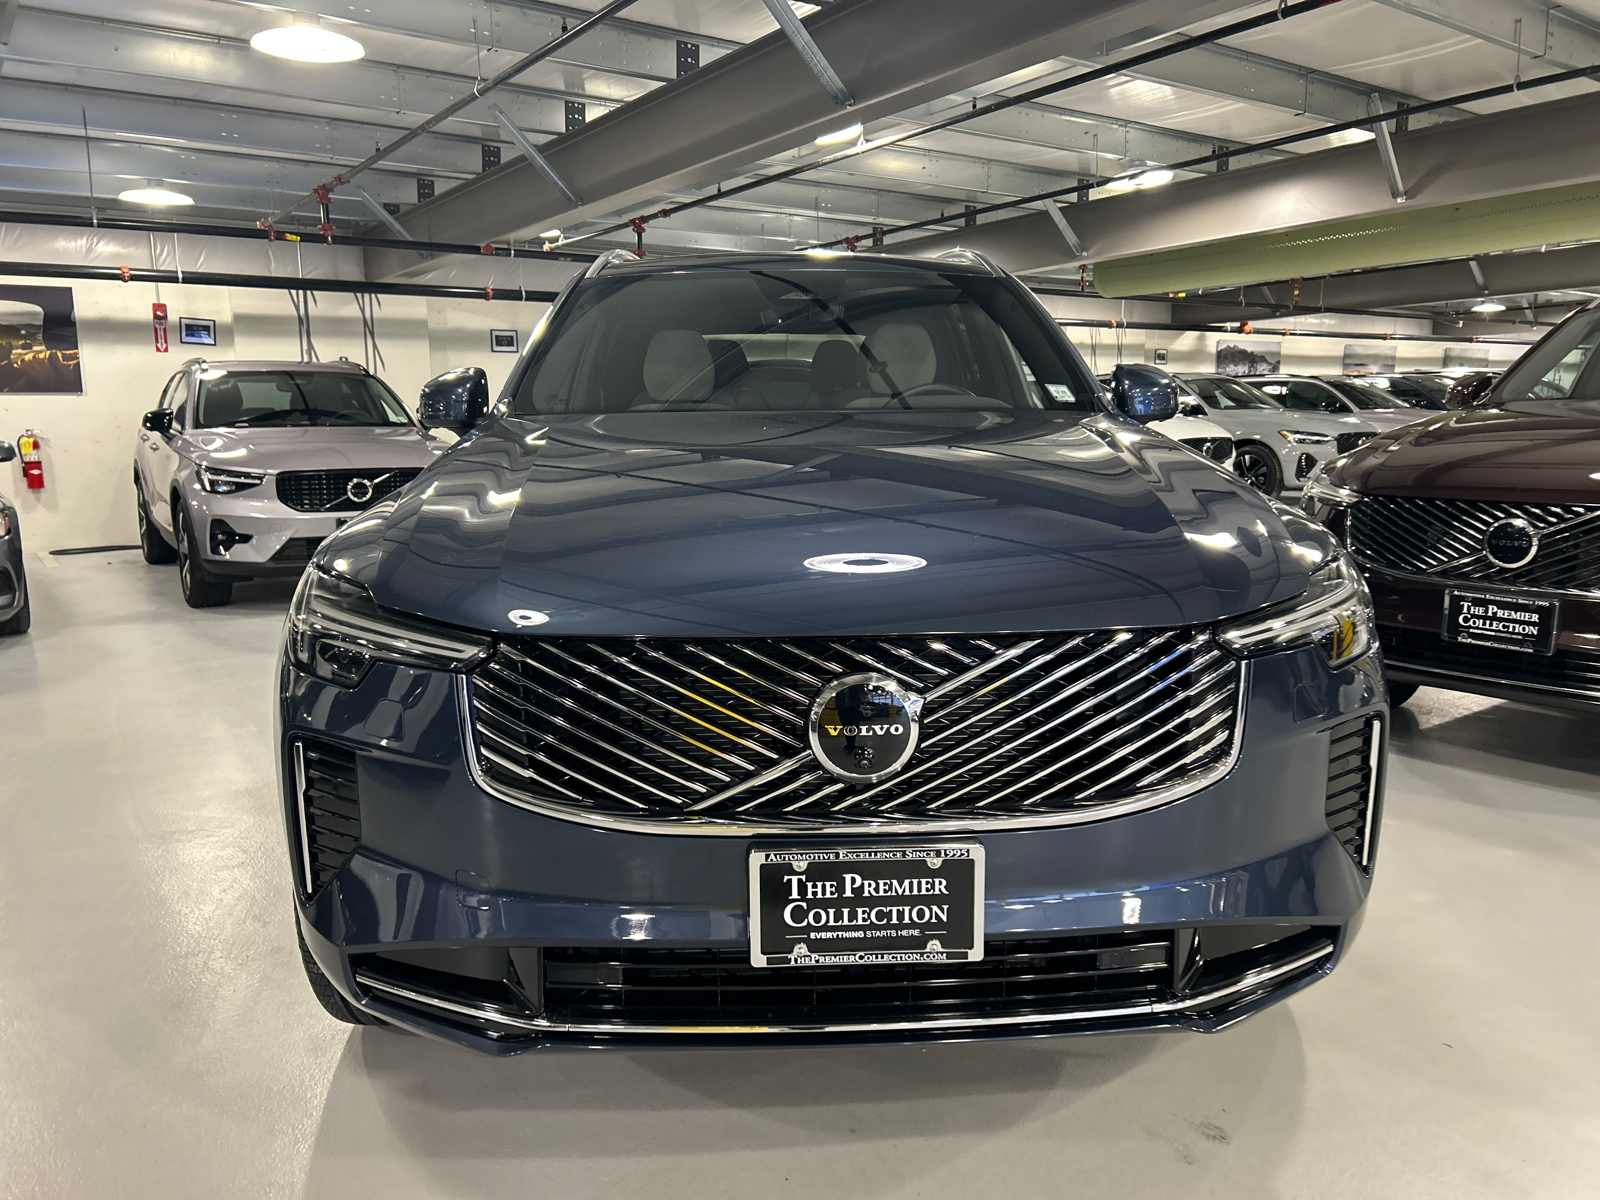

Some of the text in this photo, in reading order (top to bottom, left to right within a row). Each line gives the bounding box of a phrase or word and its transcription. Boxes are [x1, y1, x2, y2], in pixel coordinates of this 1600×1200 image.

[1460, 601, 1540, 622] THE PREMIER
[1458, 613, 1539, 635] COLLECTION
[825, 724, 904, 736] VOLVO
[767, 849, 968, 862] AUTOMOTIVE EXCELLENCE SINCE 1995
[783, 873, 949, 899] THE PREMIER
[783, 901, 949, 927] COLLECTION
[810, 928, 922, 939] EVERYTHING STARTS HERE.
